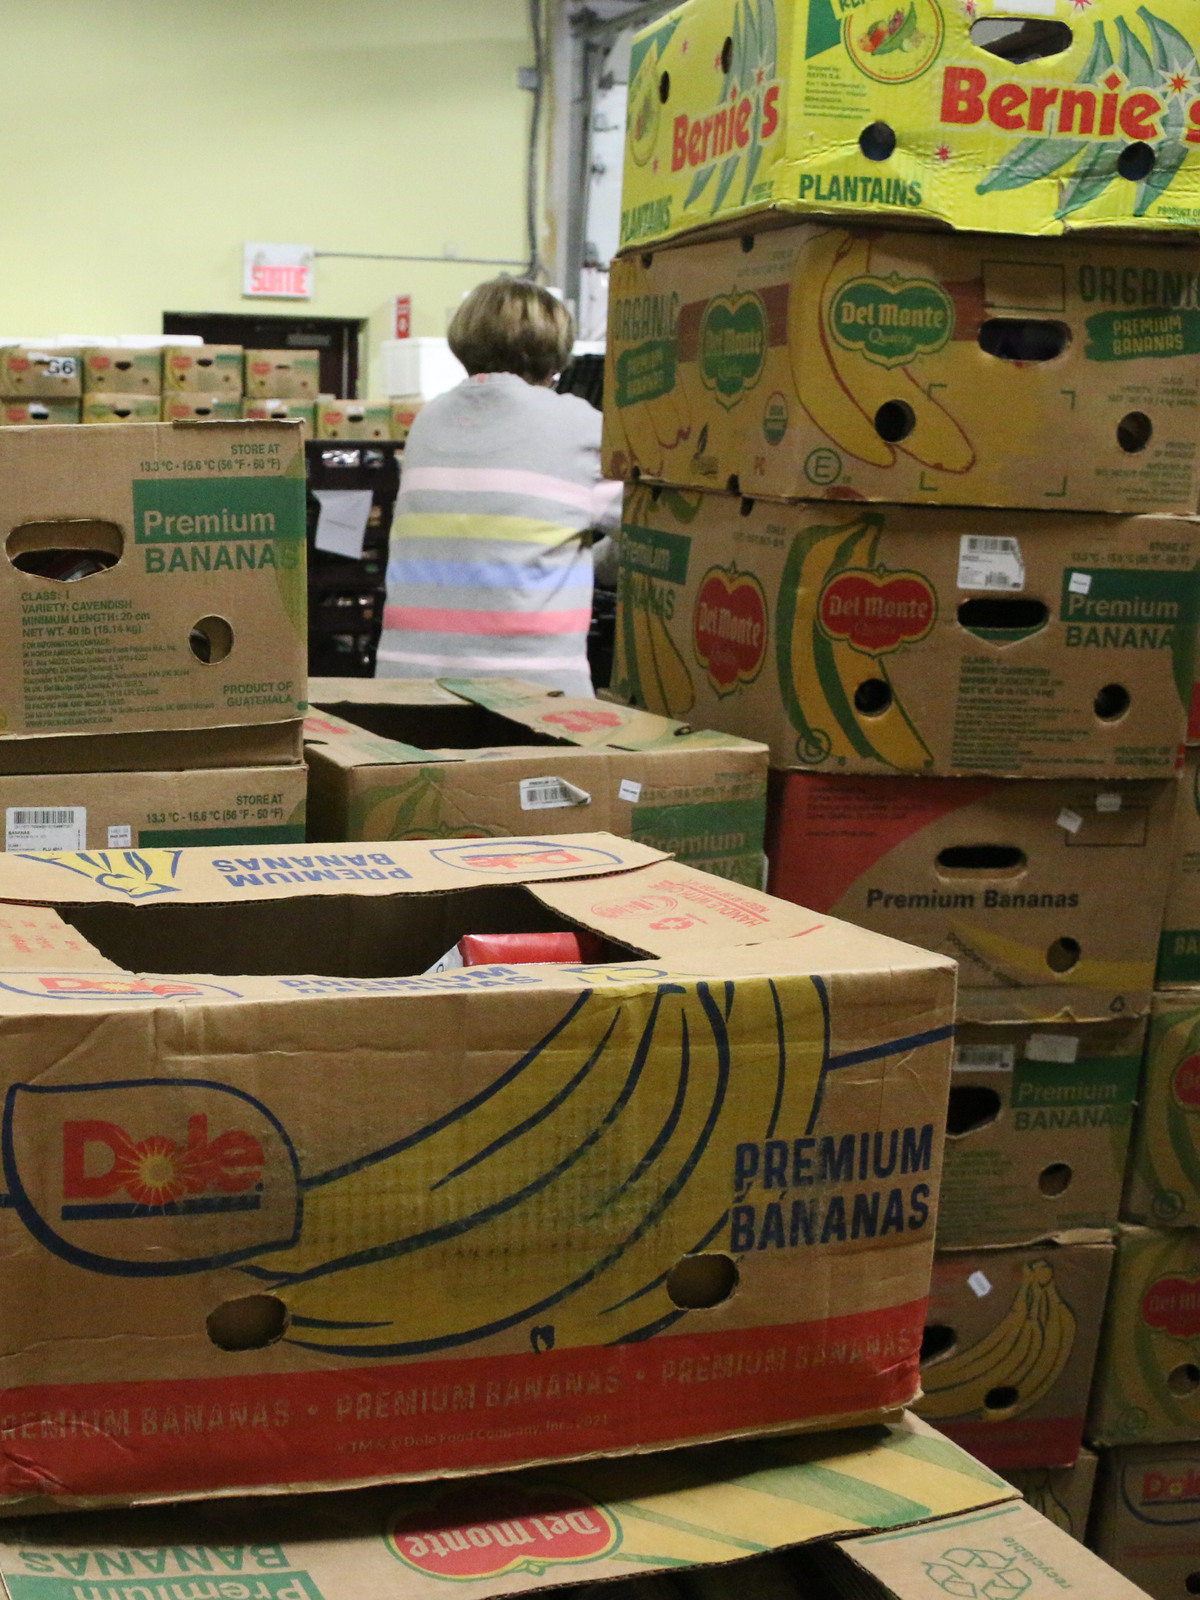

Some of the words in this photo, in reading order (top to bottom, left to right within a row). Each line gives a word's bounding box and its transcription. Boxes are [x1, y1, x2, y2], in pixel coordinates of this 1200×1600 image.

[799, 174, 922, 207] PLANTAINS
[250, 264, 309, 294] SORTIE
[1079, 264, 1200, 307] ORGANI
[841, 301, 875, 326] Del
[878, 302, 944, 328] Monte
[1112, 315, 1182, 336] PREMIUM
[1112, 334, 1184, 356] BANANAS
[231, 444, 265, 455] STORE
[267, 443, 281, 454] AT
[143, 508, 276, 537] Premium
[21, 591, 62, 601] CLASS:
[22, 603, 70, 614] VARIETY:
[72, 600, 133, 613] CAVENDISH
[829, 593, 860, 618] Del
[862, 594, 928, 620] Monte
[1068, 594, 1179, 618] Premium
[22, 615, 70, 626] MINIMUM
[72, 613, 119, 624] LENGTH:
[121, 612, 133, 621] 20
[722, 607, 761, 649] Monte
[23, 627, 44, 638] NET
[67, 627, 79, 636] 40
[1066, 626, 1175, 650] BANANA
[223, 683, 272, 697] PRODUCT
[277, 682, 294, 694] OF
[227, 694, 293, 707] GUATEMALA
[236, 794, 269, 806] STORE
[271, 793, 284, 804] AT
[212, 852, 396, 874] BANANAS
[225, 867, 414, 889] PREMIUM
[866, 888, 977, 910] Premium
[984, 889, 1080, 909] Bananas
[38, 976, 201, 995] Dole
[1018, 1080, 1118, 1101] Premium
[1014, 1107, 1112, 1132] BANANA
[62, 1112, 266, 1208] Dole
[734, 1123, 934, 1192] PREMIUM
[730, 1183, 931, 1255] BANANAS
[141, 1400, 291, 1438] BANANAS
[336, 1378, 476, 1422] PREMIUM
[485, 1363, 622, 1408] BANANAS
[660, 1352, 788, 1390] PREMIUM
[404, 1434, 437, 1449] Dole
[535, 1509, 602, 1542] Del
[403, 1517, 527, 1560] Monte
[17, 1544, 292, 1578] BANANAS
[1002, 1535, 1075, 1591] recyclable
